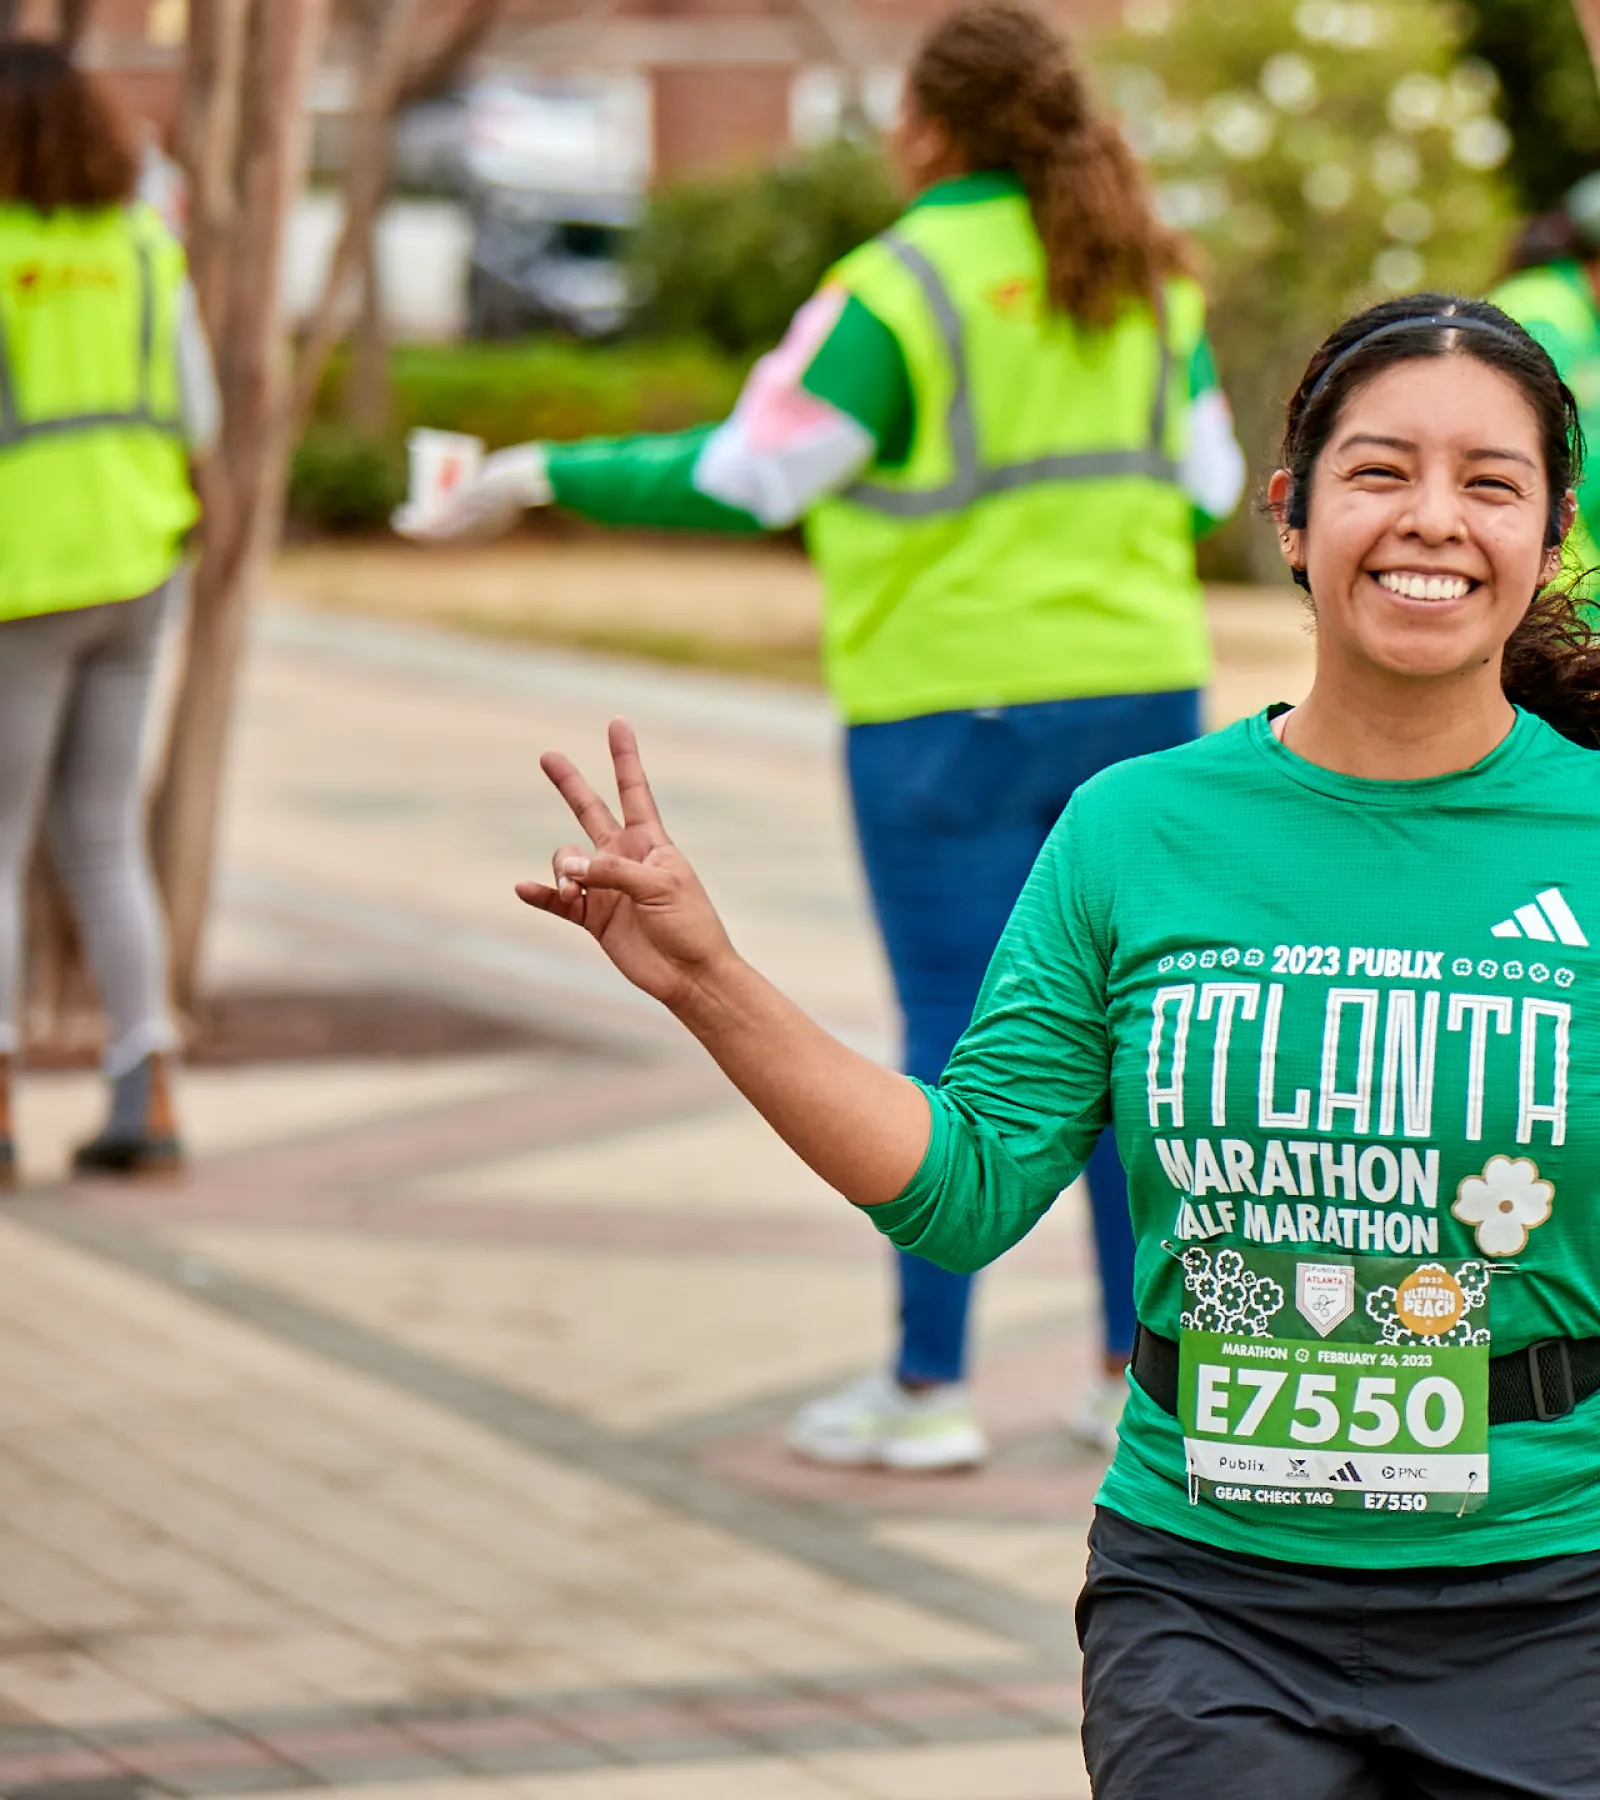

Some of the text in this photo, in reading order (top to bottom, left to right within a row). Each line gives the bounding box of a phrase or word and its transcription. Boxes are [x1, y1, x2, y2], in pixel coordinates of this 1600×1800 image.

[1273, 944, 1445, 980] 2023 PUBLIX
[1147, 983, 1571, 1146] ATLANTA
[1155, 1138, 1440, 1208] MARATHON
[1243, 1200, 1439, 1255] MARATHON
[1307, 1276, 1343, 1285] ATLANTA
[1403, 1286, 1456, 1302] ULTIMATE
[1403, 1298, 1456, 1318] PEACH
[1221, 1342, 1433, 1369] MARATHON FEBRUARY 26, 2023
[1195, 1364, 1465, 1449] E7550
[1398, 1467, 1428, 1480] PNC
[1215, 1486, 1428, 1512] GEAR CHECK TAG E7550
